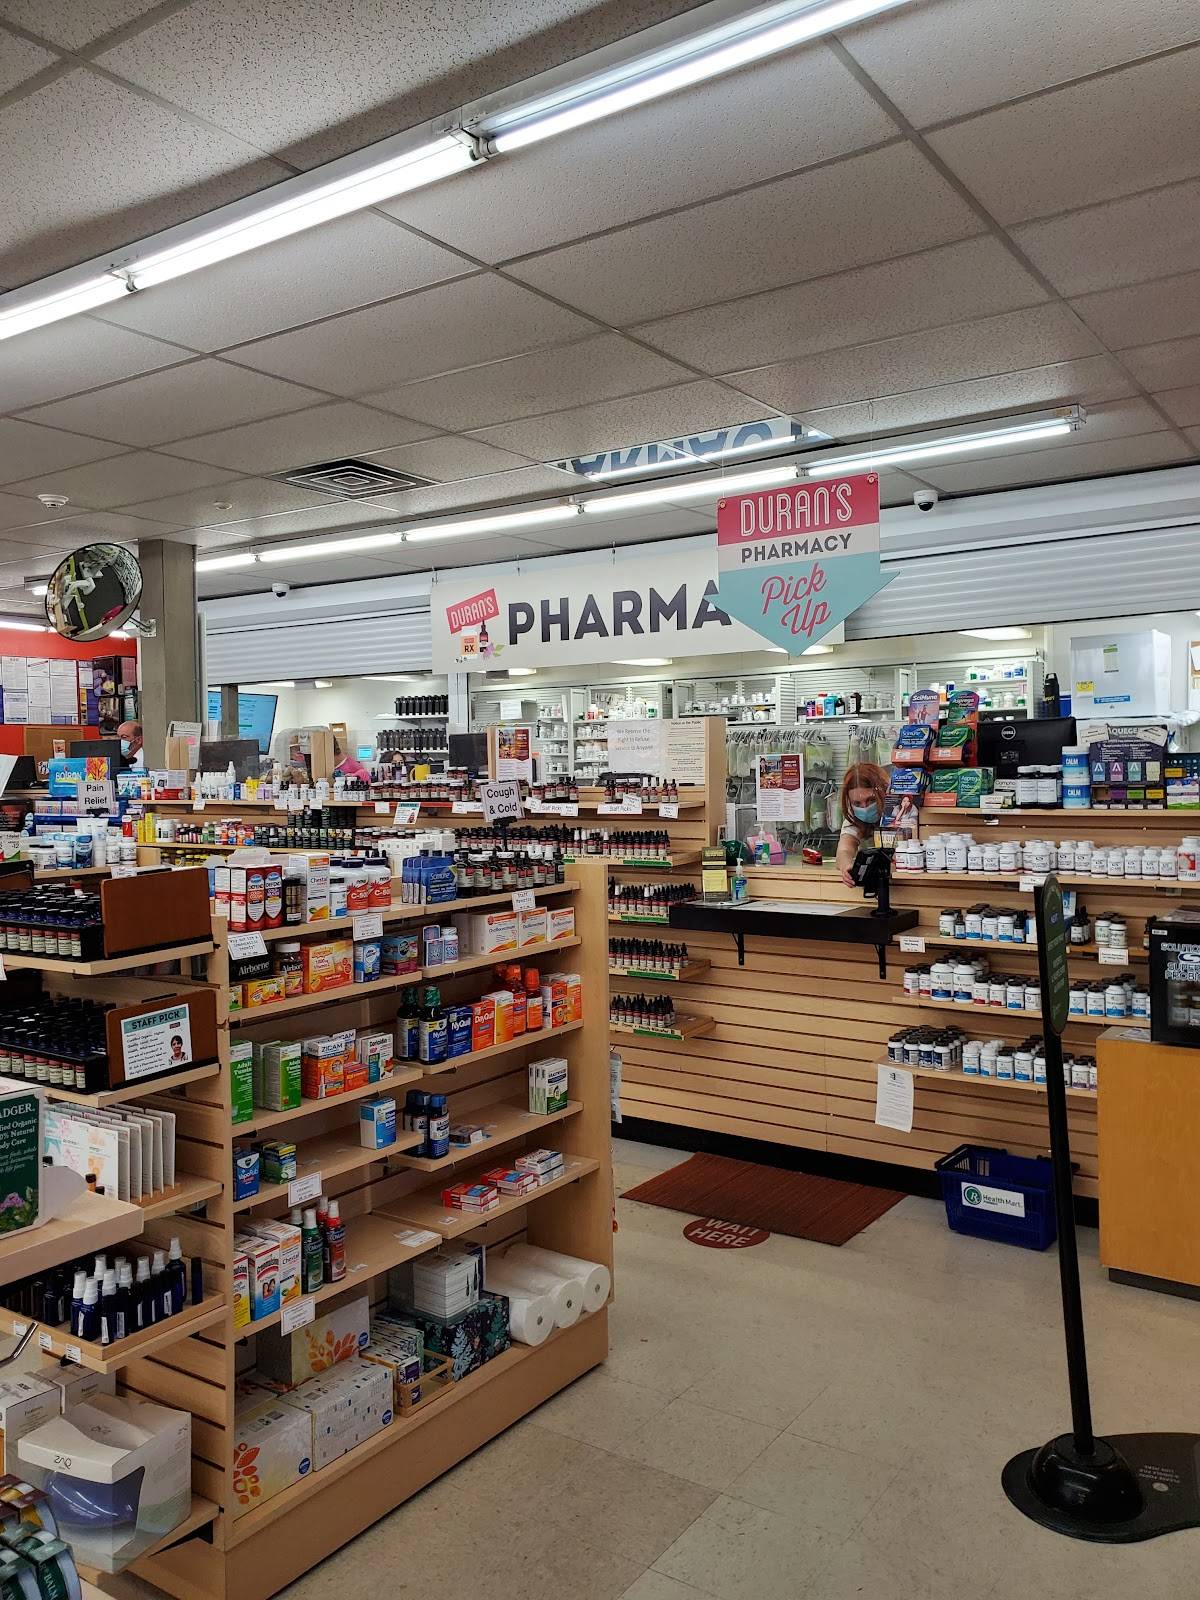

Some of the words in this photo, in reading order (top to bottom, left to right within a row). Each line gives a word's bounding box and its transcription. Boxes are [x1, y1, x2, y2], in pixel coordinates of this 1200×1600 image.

[740, 482, 853, 538] DURAN'S
[740, 532, 853, 564] PHARMACY
[761, 561, 827, 615] Pick
[450, 596, 495, 629] DURAN'S
[780, 598, 832, 639] Up
[464, 644, 475, 653] RX
[86, 784, 104, 792] Pain
[486, 788, 515, 799] Cough
[84, 797, 108, 805] Relief
[489, 805, 496, 815] &
[496, 803, 518, 814] Cold
[238, 960, 270, 976] Airborne
[131, 1016, 157, 1030] STAFF
[159, 1010, 180, 1023] PICK
[474, 1010, 495, 1024] DayQuil
[451, 1018, 471, 1031] NyQuil
[321, 1042, 344, 1053] ZICAM
[12, 1118, 38, 1129] Organic
[10, 1126, 35, 1138] Natural
[11, 1138, 27, 1146] Care
[982, 1194, 1005, 1204] Health
[687, 1228, 751, 1247] HERE
